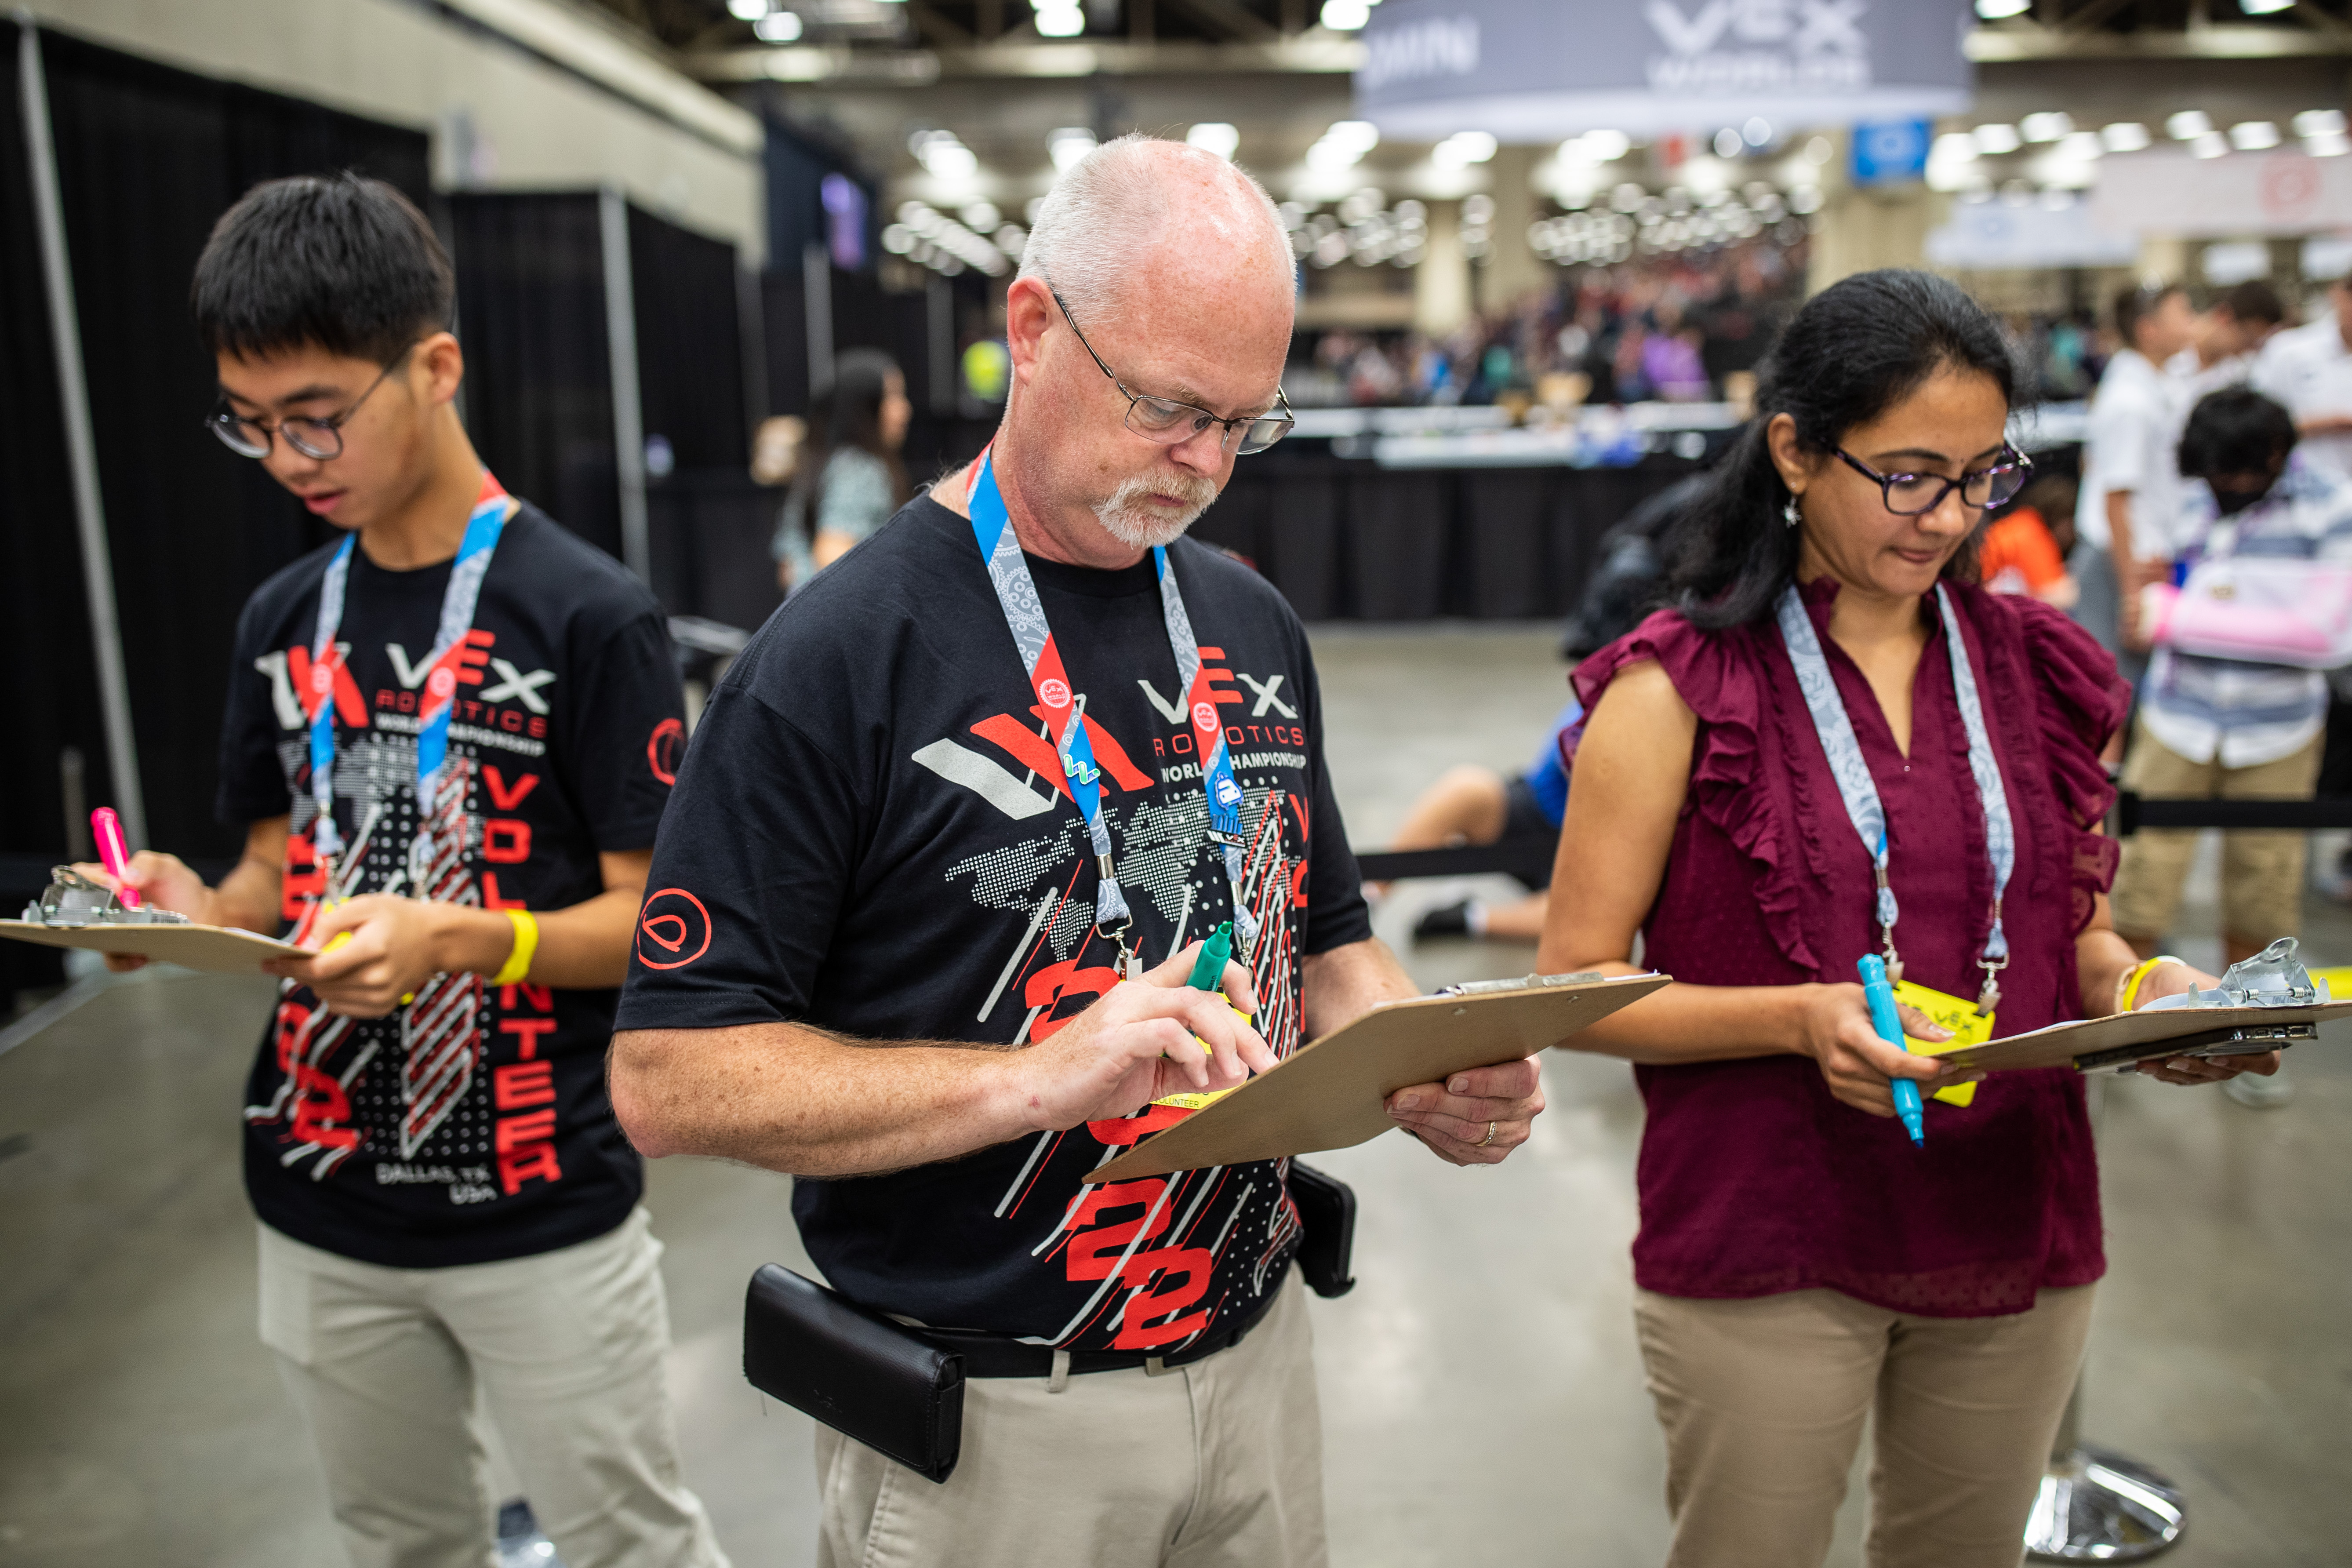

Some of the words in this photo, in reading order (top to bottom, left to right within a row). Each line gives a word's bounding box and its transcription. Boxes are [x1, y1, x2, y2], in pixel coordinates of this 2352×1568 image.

[385, 629, 557, 715] VEX
[1137, 647, 1298, 724] VEX
[1153, 726, 1304, 757] ROOTICS
[1161, 761, 1203, 783] WORL
[1229, 752, 1306, 770] HAMPIONSHIP
